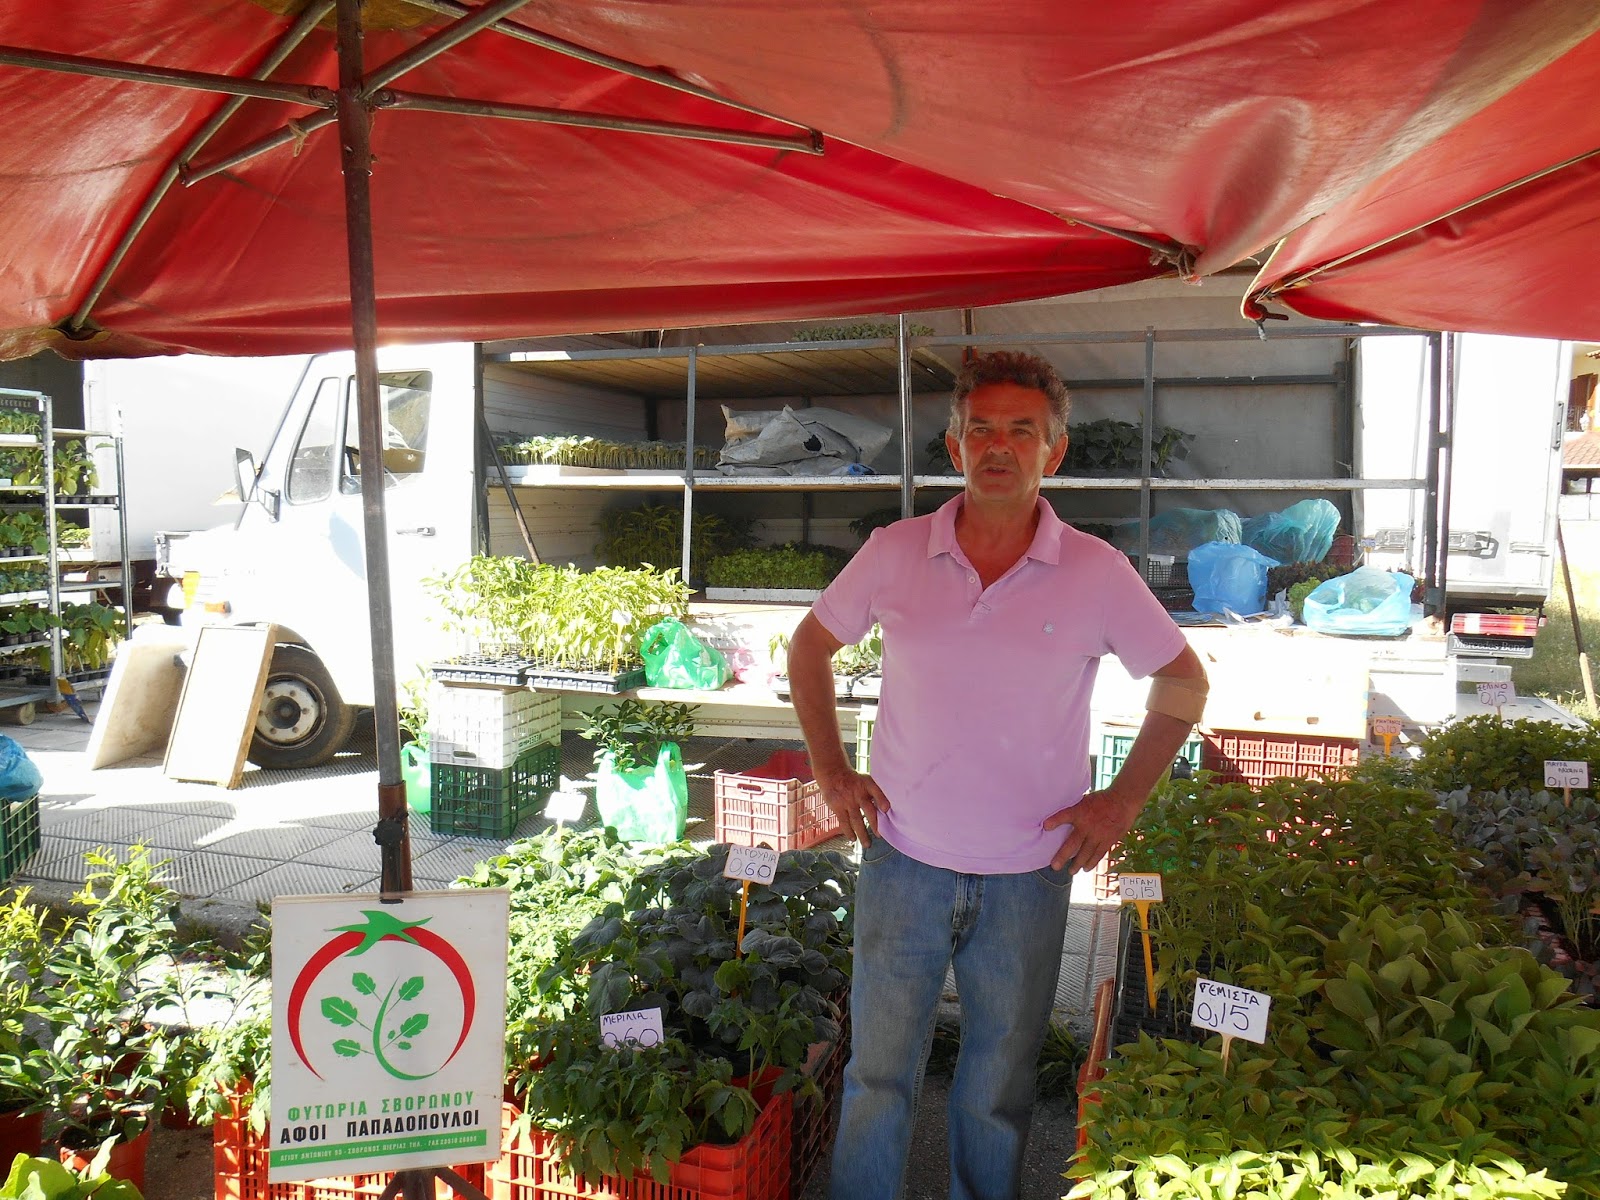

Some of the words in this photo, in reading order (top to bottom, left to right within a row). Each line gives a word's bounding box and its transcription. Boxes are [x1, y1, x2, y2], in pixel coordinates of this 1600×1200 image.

[1480, 690, 1508, 706] 0,15
[729, 857, 772, 878] 0,60
[1124, 886, 1155, 900] 0,15
[1199, 982, 1260, 1006] ΓΕΜΙΣΤΑ
[1197, 1002, 1249, 1031] 0,15
[287, 1100, 368, 1122] ΦΥΤΩΡΙΑ
[381, 1091, 474, 1113] ΣΒΟΡΩΝΟΥ
[280, 1124, 327, 1144] ΑΦΟΙ
[346, 1109, 479, 1138] ΠΑΠΑΔΟΠΟΥΛΟΙ
